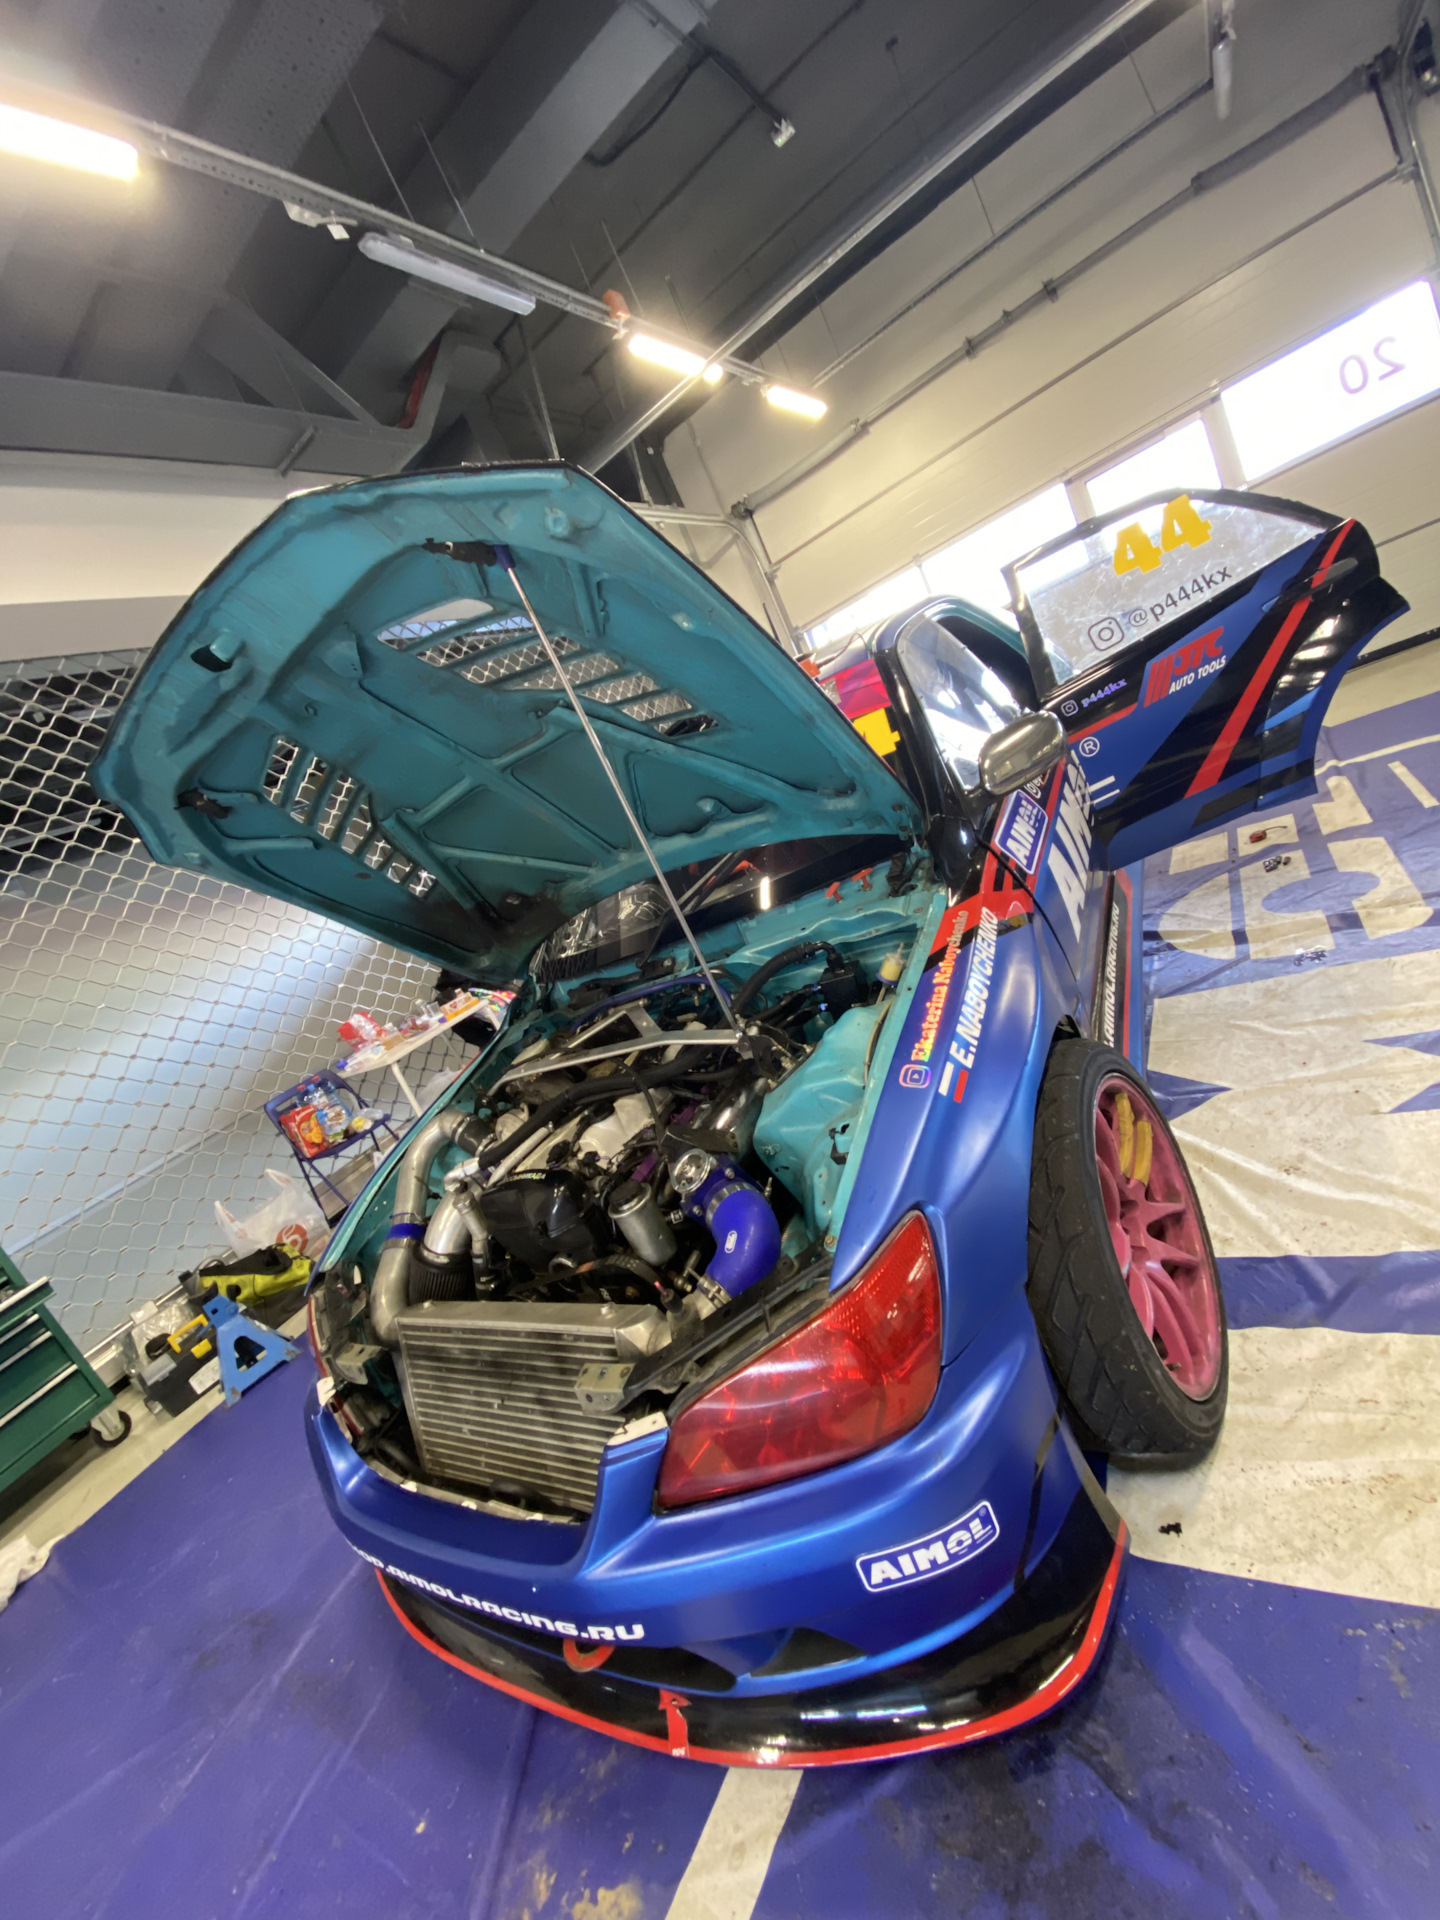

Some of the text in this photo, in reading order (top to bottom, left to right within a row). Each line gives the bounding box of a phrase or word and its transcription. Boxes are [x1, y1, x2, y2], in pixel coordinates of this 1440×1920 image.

[1113, 494, 1212, 576] 44
[1128, 567, 1232, 628] @p444kx
[1168, 655, 1227, 695] AUTO TOOLS
[949, 906, 999, 1069] E.NABOYCHENKO
[1104, 901, 1120, 1048] .AIMOLRACING.RU
[911, 983, 948, 1062] Ekaterina
[870, 1517, 994, 1586] AIMOL
[352, 1545, 645, 1641] OP.AIMOLRACING.RU
